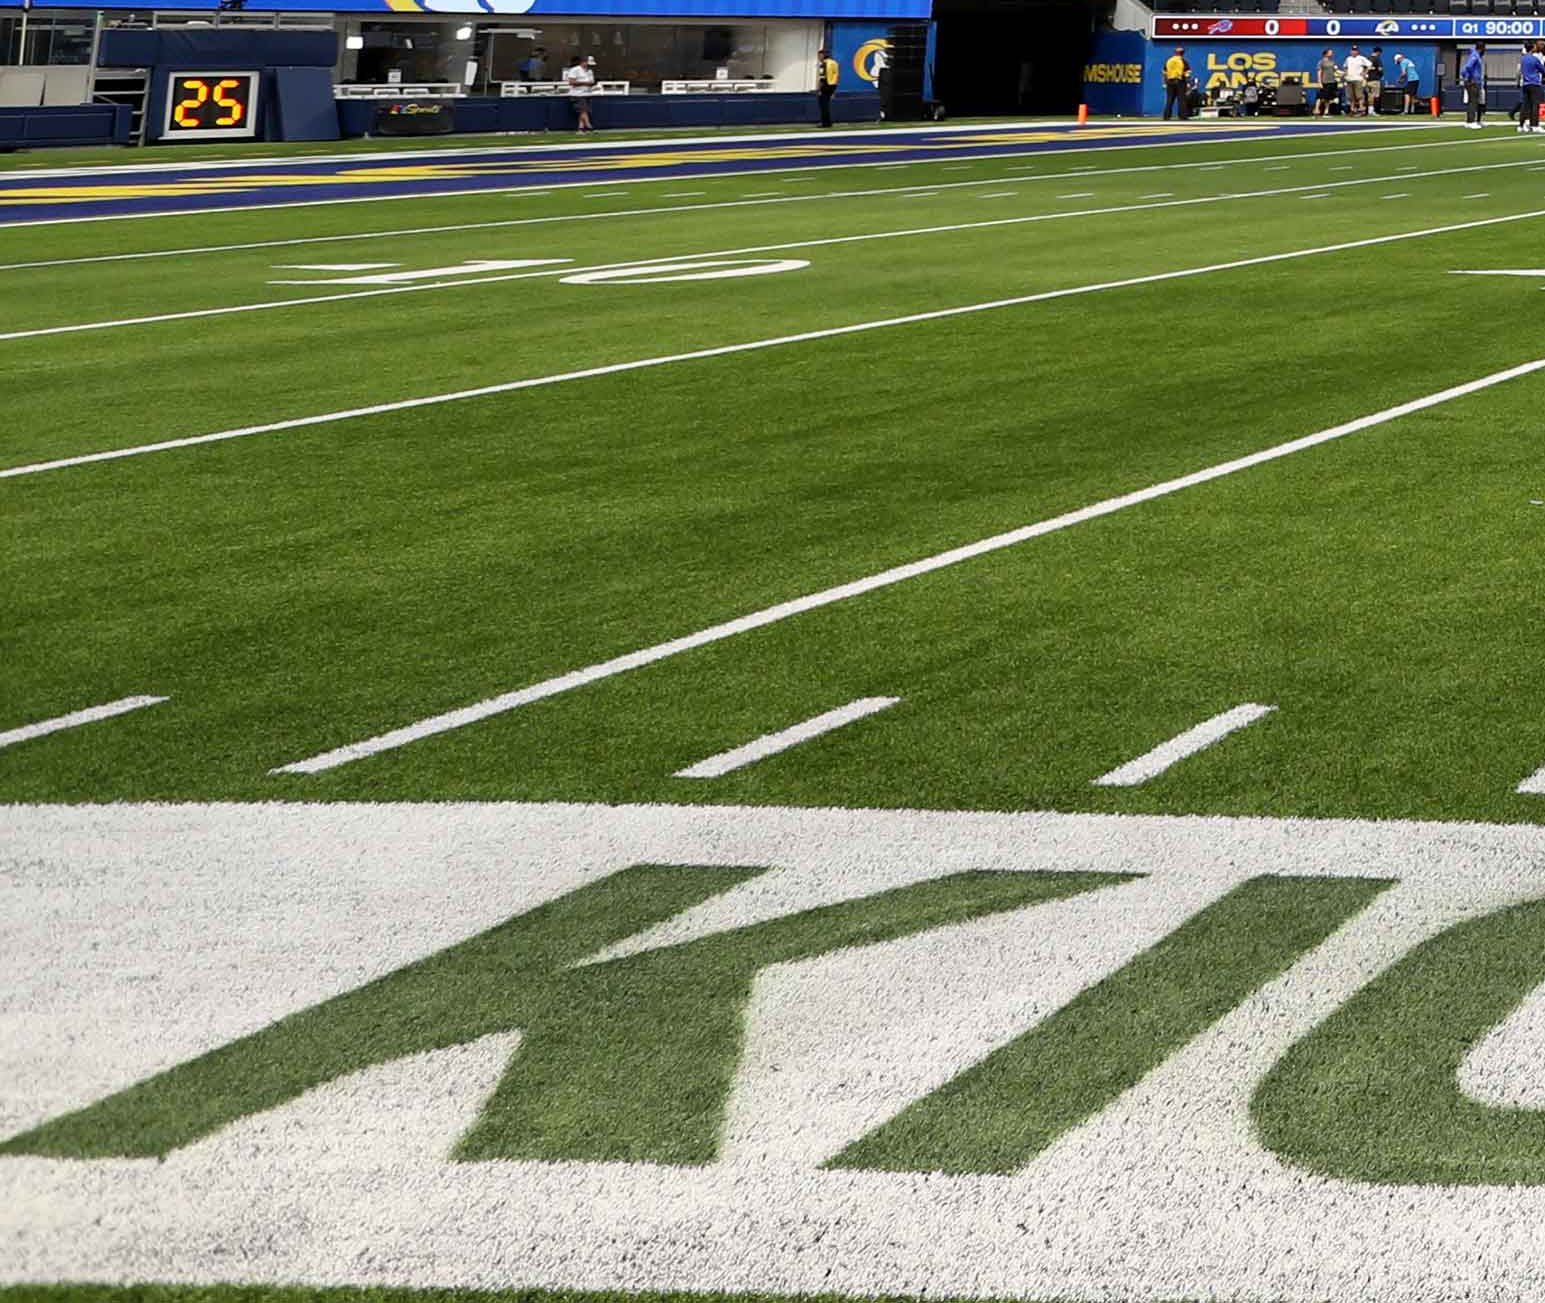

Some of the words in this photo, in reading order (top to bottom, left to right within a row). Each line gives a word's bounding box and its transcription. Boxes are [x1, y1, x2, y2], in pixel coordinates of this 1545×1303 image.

[1265, 20, 1280, 36] 0
[1327, 20, 1341, 36] 0
[1462, 23, 1479, 35] Q1
[1486, 20, 1534, 35] 90:00
[1207, 53, 1277, 70] LOS
[175, 79, 245, 127] 25
